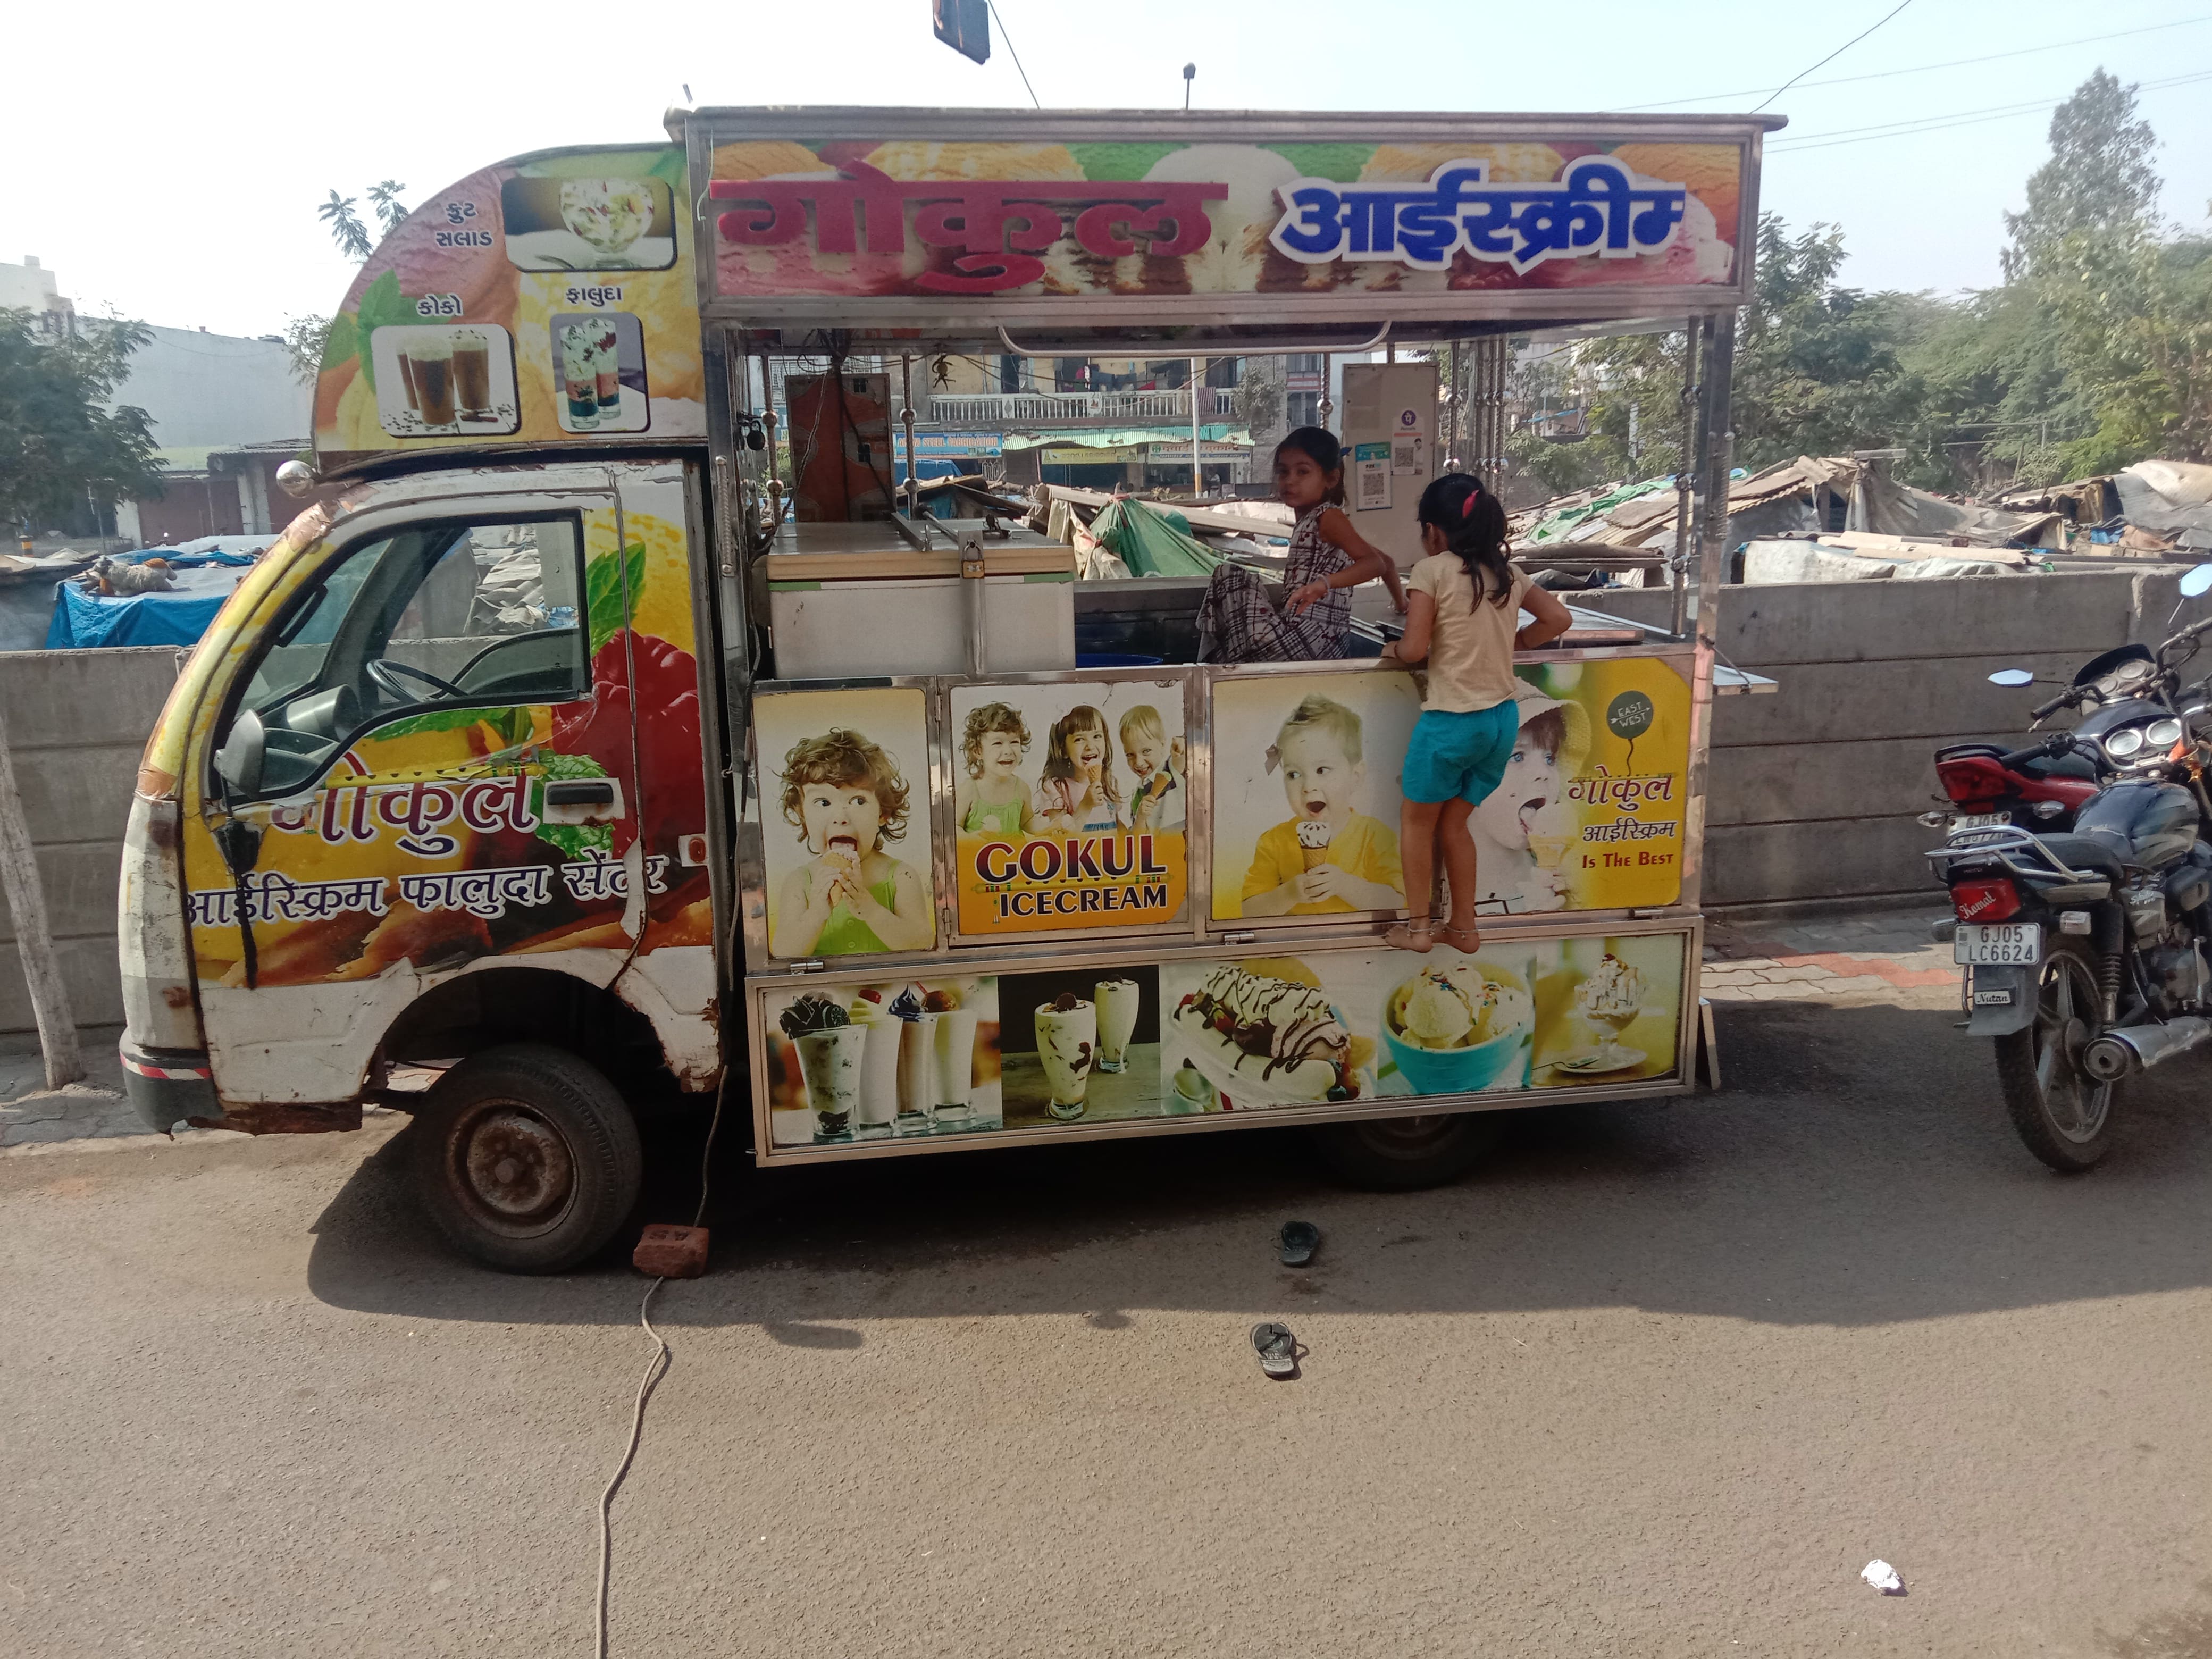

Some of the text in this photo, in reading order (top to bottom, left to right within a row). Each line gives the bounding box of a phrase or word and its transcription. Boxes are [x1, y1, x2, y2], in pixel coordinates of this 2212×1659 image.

[709, 158, 1228, 292] गोकुल
[436, 231, 492, 246] સલાડ
[418, 295, 461, 314] કોકો
[565, 288, 622, 307] ફાલુદા
[1618, 701, 1641, 717] EAST
[1619, 712, 1646, 728] WEST
[1568, 765, 1672, 811] गोकुल
[976, 835, 1166, 883] GOKUL
[400, 867, 548, 915] फालुदा
[1000, 884, 1167, 917] ICECREAM
[1959, 891, 1996, 919] Komal
[1981, 926, 2023, 943] GJ05
[1969, 944, 2033, 961] LC6624
[1977, 993, 2008, 1003] Nutan
